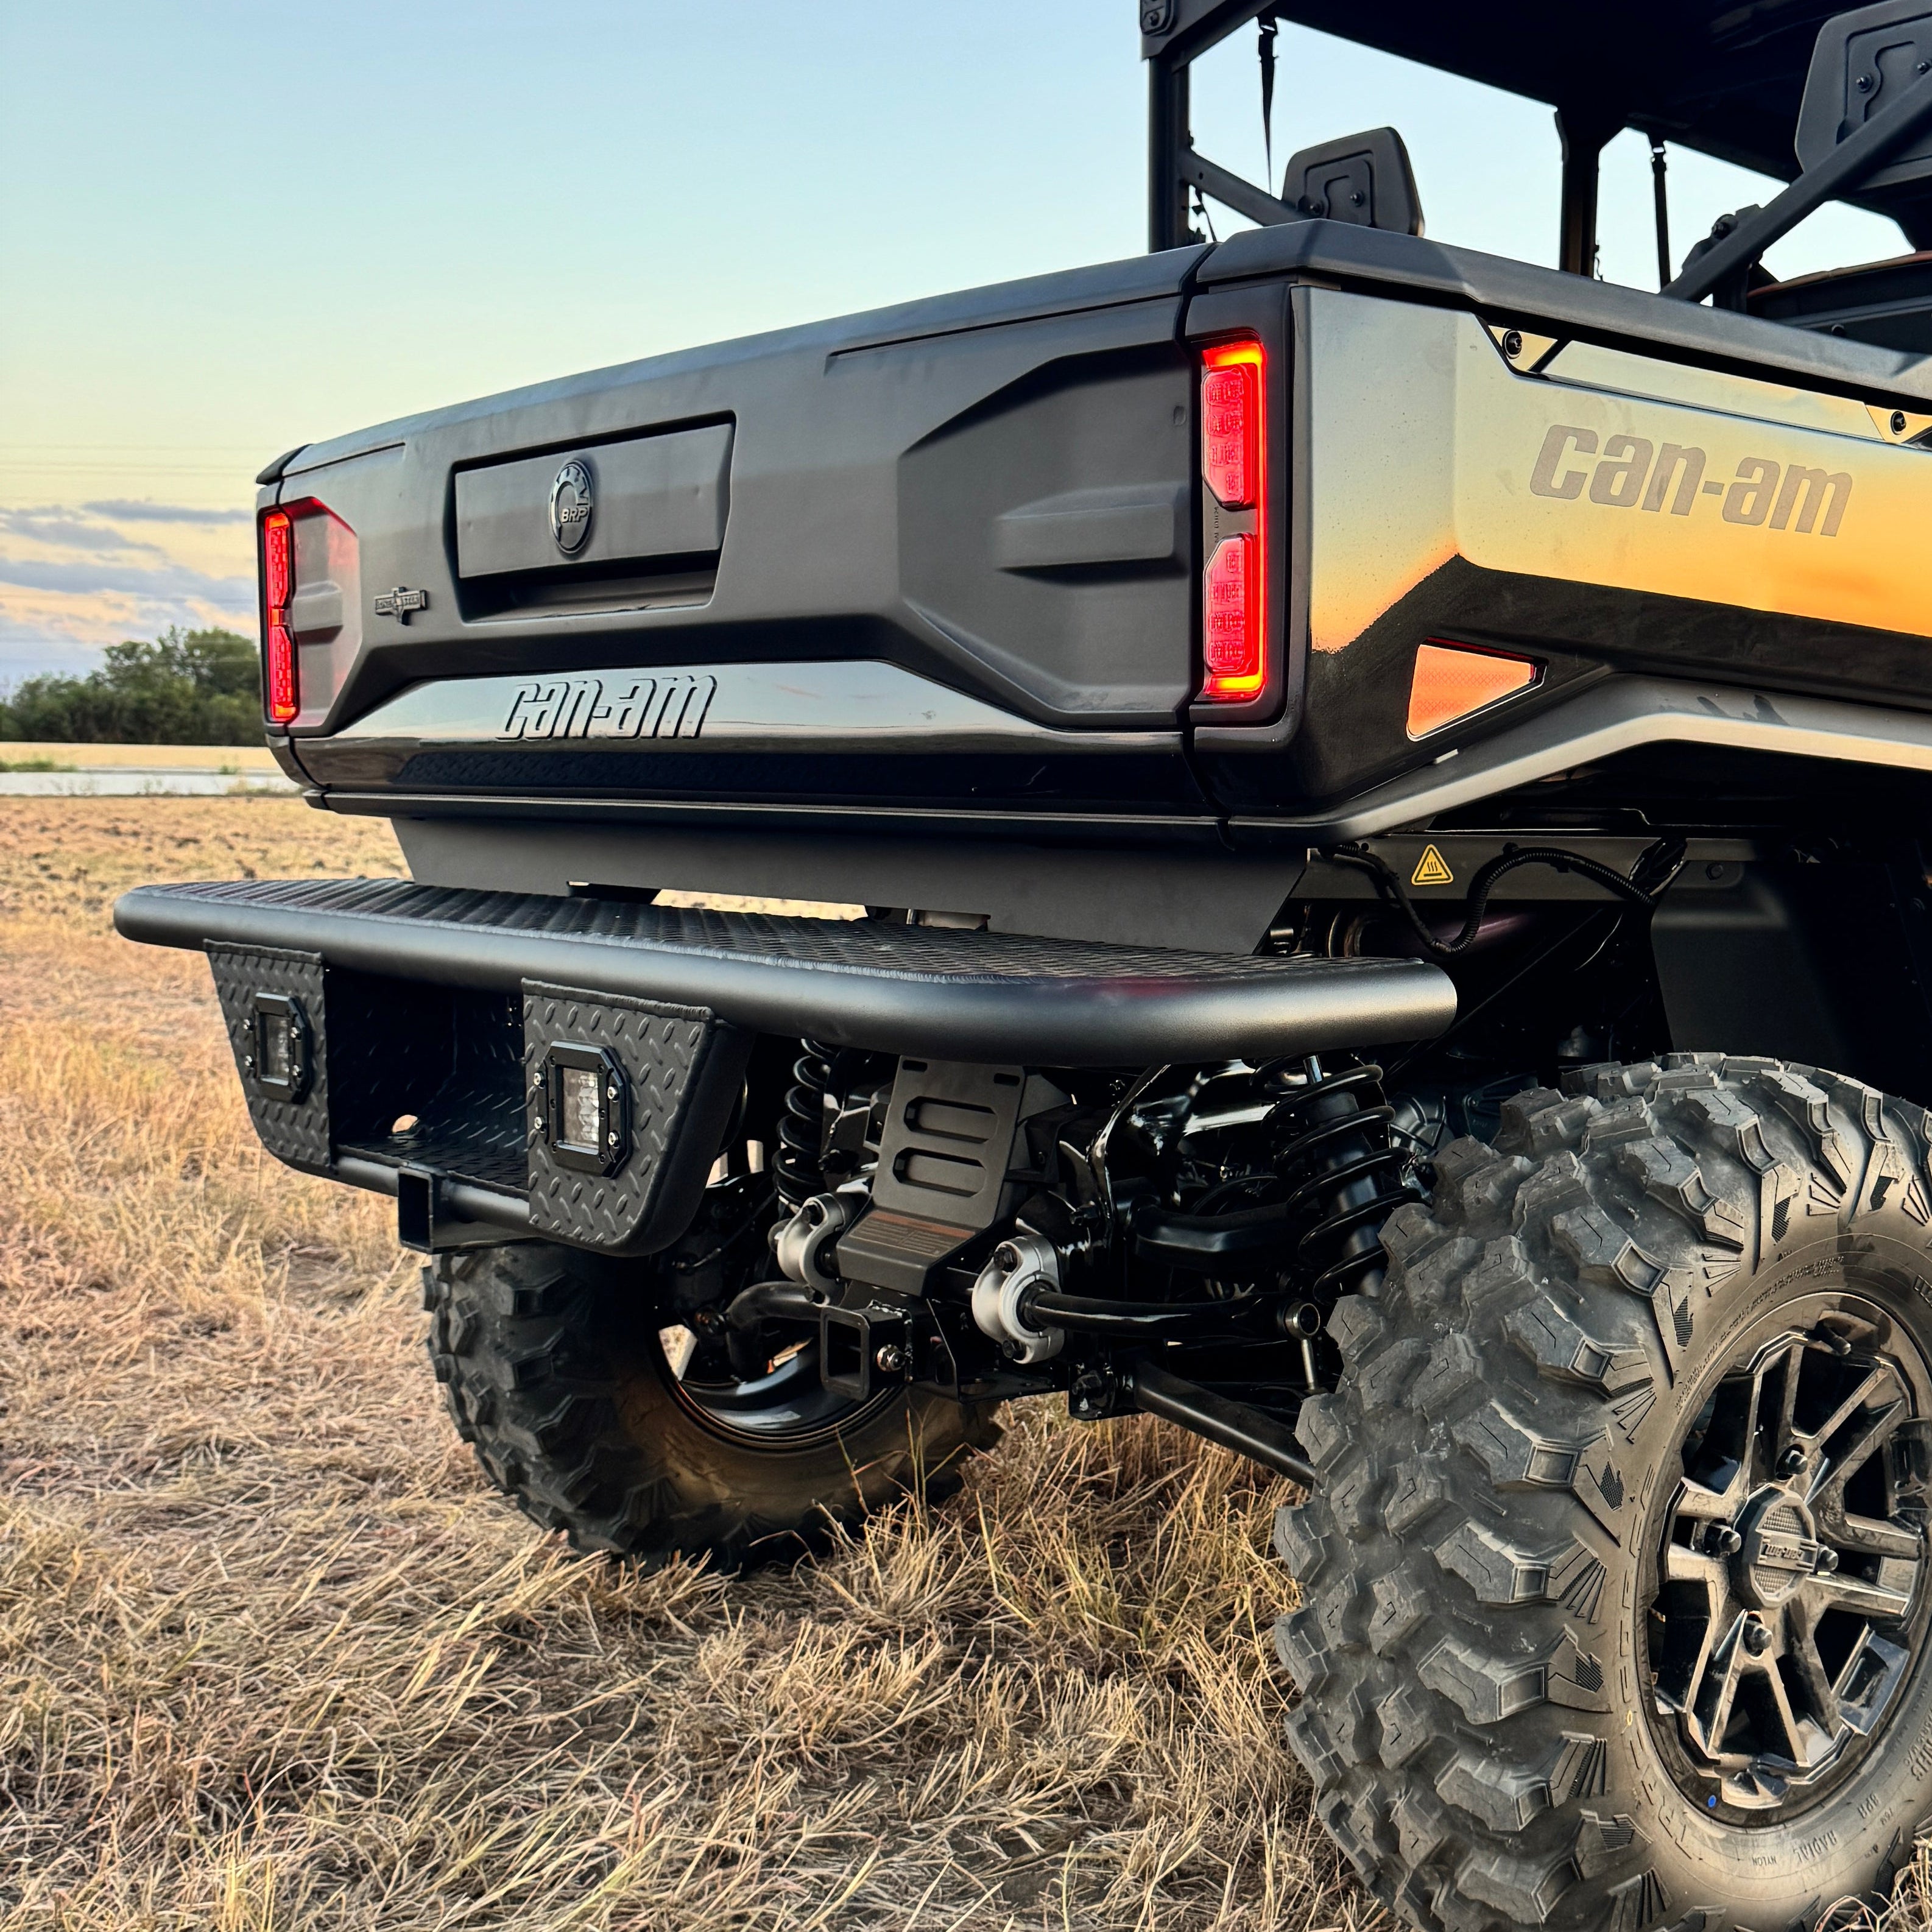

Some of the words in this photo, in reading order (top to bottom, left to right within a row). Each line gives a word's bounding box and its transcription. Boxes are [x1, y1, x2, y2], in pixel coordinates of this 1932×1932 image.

[1530, 425, 1852, 537] can-am
[562, 507, 588, 523] BRP
[1793, 1829, 1838, 1863] RADIAL
[1752, 1856, 1777, 1866] NYLON
